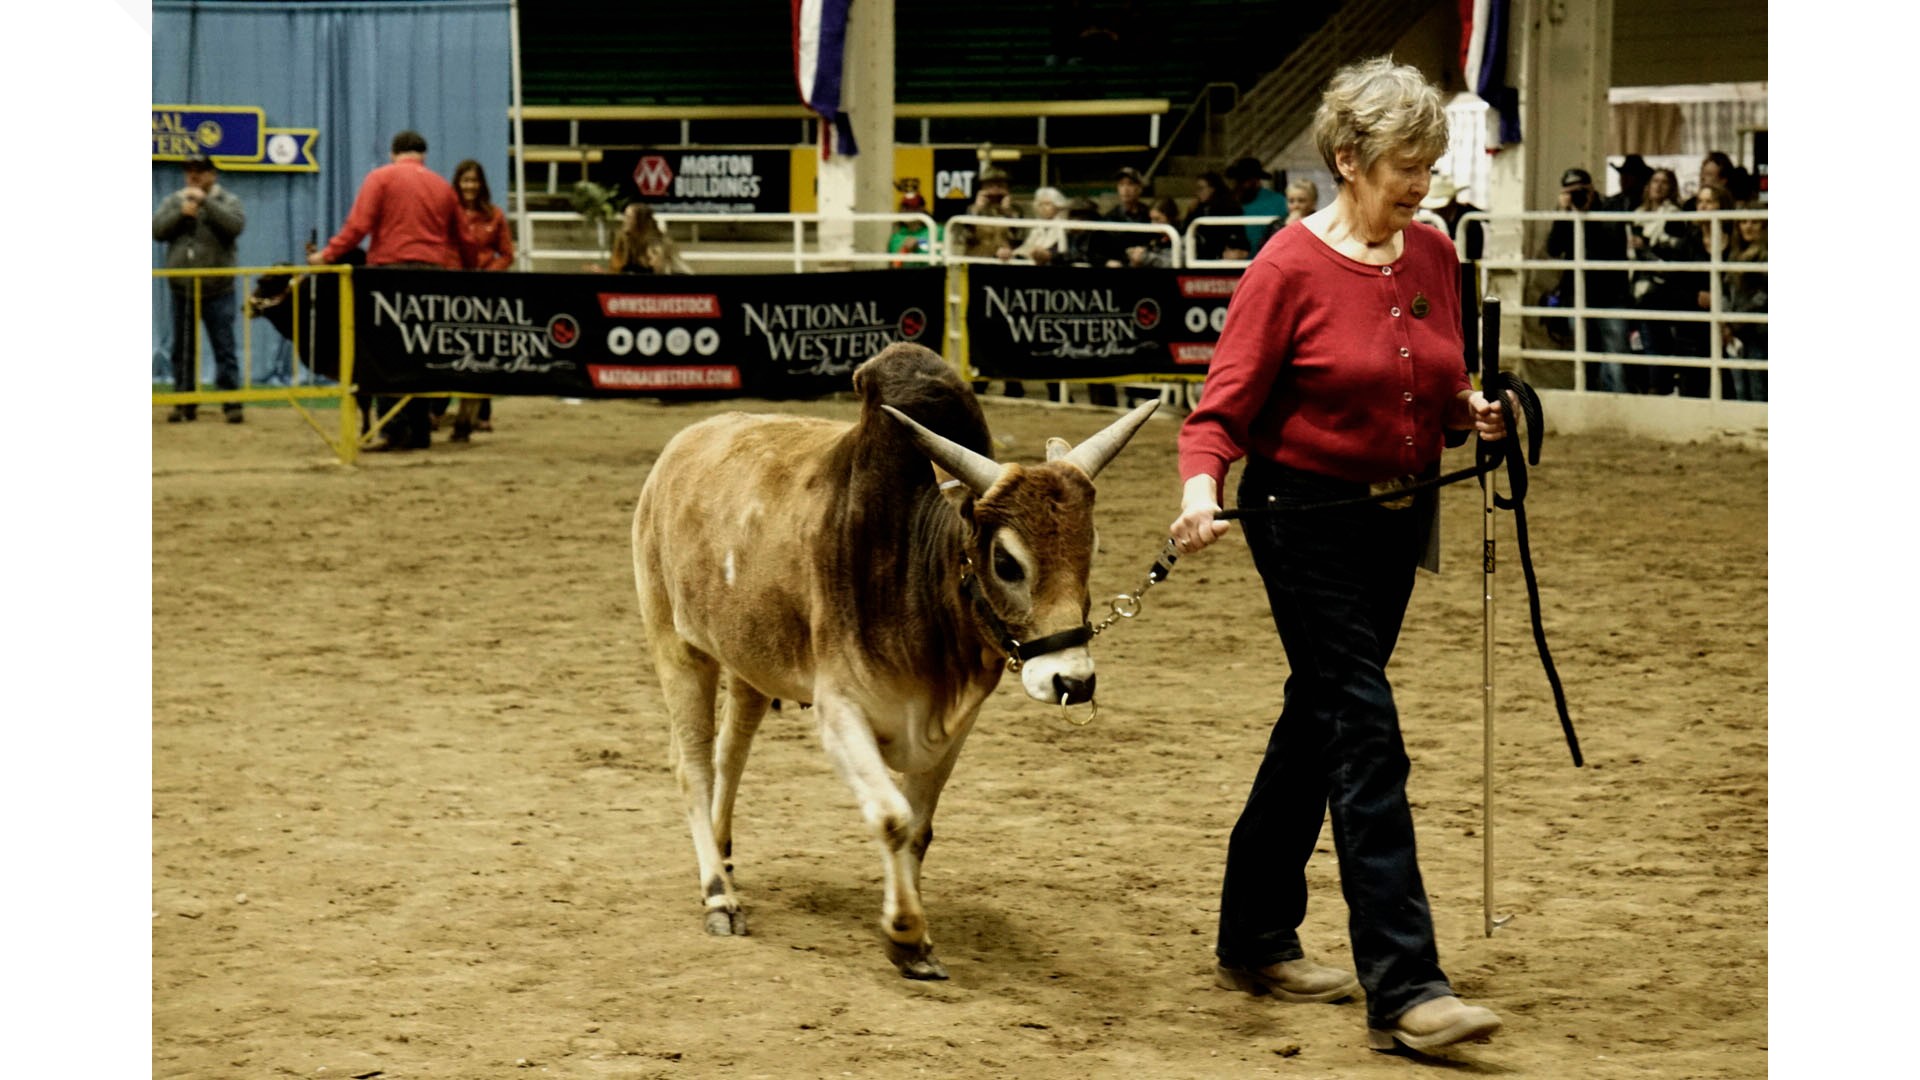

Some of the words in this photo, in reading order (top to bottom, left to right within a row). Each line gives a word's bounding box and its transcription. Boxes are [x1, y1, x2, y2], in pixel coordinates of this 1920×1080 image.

[679, 155, 753, 175] MORTON
[674, 176, 761, 198] BUILDINGS
[936, 170, 976, 199] CAT
[652, 201, 756, 213] ortonbuildings.com
[371, 290, 533, 327] NATIONAL
[984, 285, 1120, 318] NATIONAL
[742, 301, 885, 336] NATIONAL
[1007, 312, 1136, 343] WESTERN
[400, 322, 552, 358] WESTERN
[767, 328, 899, 361] WESTERN
